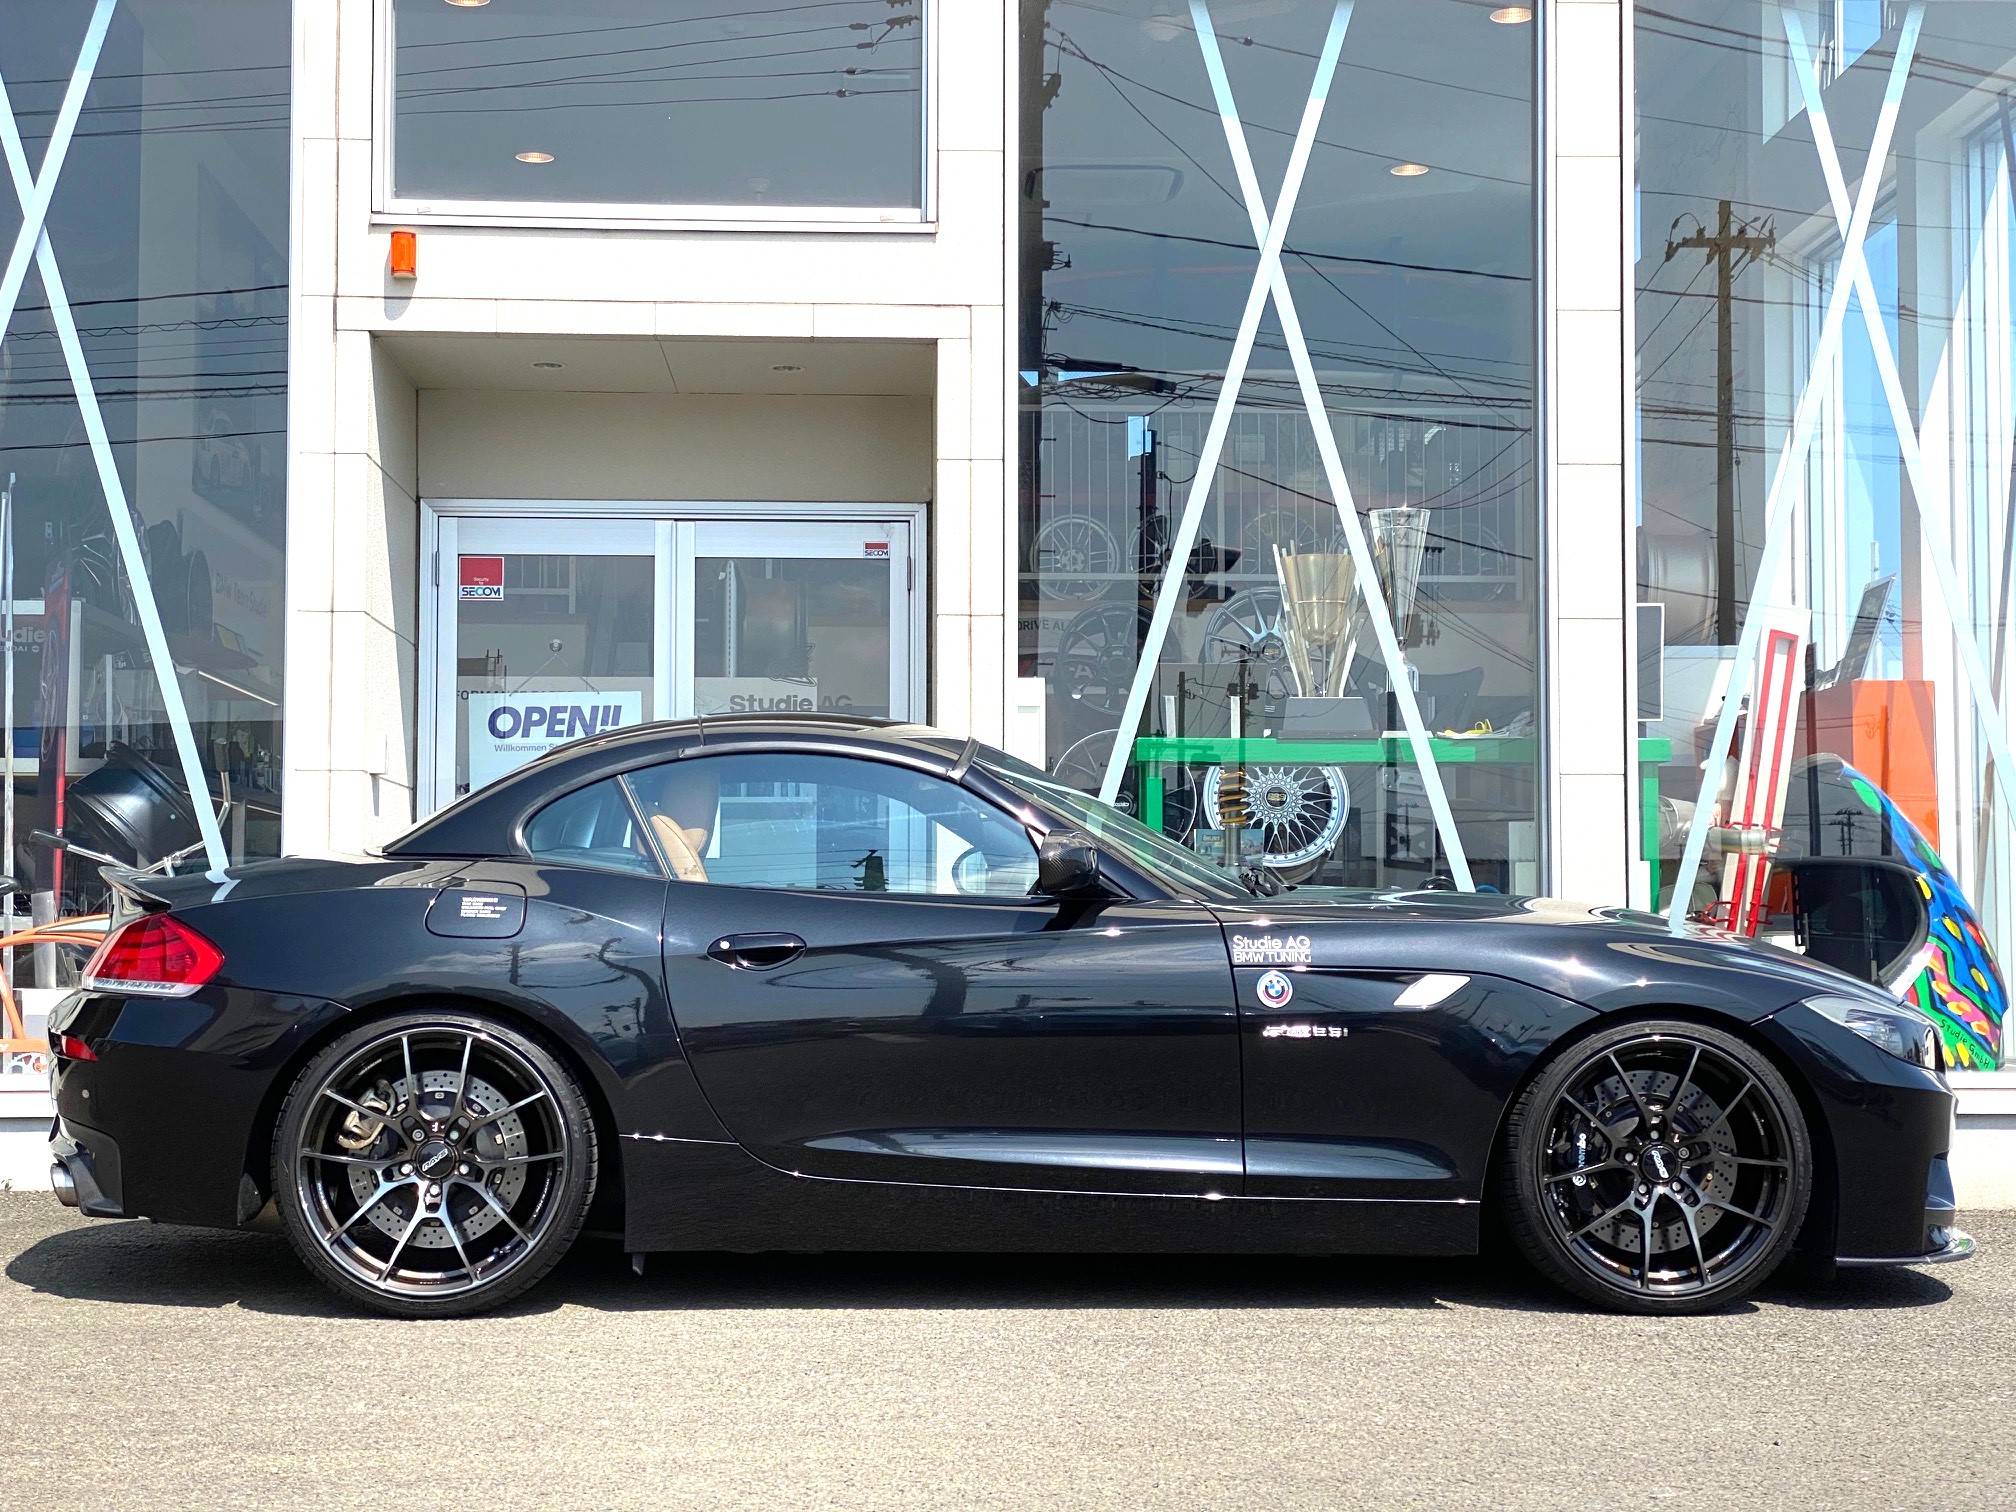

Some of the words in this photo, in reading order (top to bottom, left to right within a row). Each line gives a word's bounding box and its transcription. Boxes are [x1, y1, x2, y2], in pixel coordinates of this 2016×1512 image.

[462, 587, 500, 596] SECOM
[730, 694, 813, 712] Studie
[822, 695, 853, 712] AG
[488, 705, 622, 739] OPEN!!
[1233, 935, 1282, 949] Studie
[1286, 935, 1310, 949] AG
[1234, 952, 1264, 962] BMW
[1266, 952, 1311, 962] TUNING
[1941, 1019, 1968, 1046] Studie
[1969, 1043, 1989, 1068] GmbH
